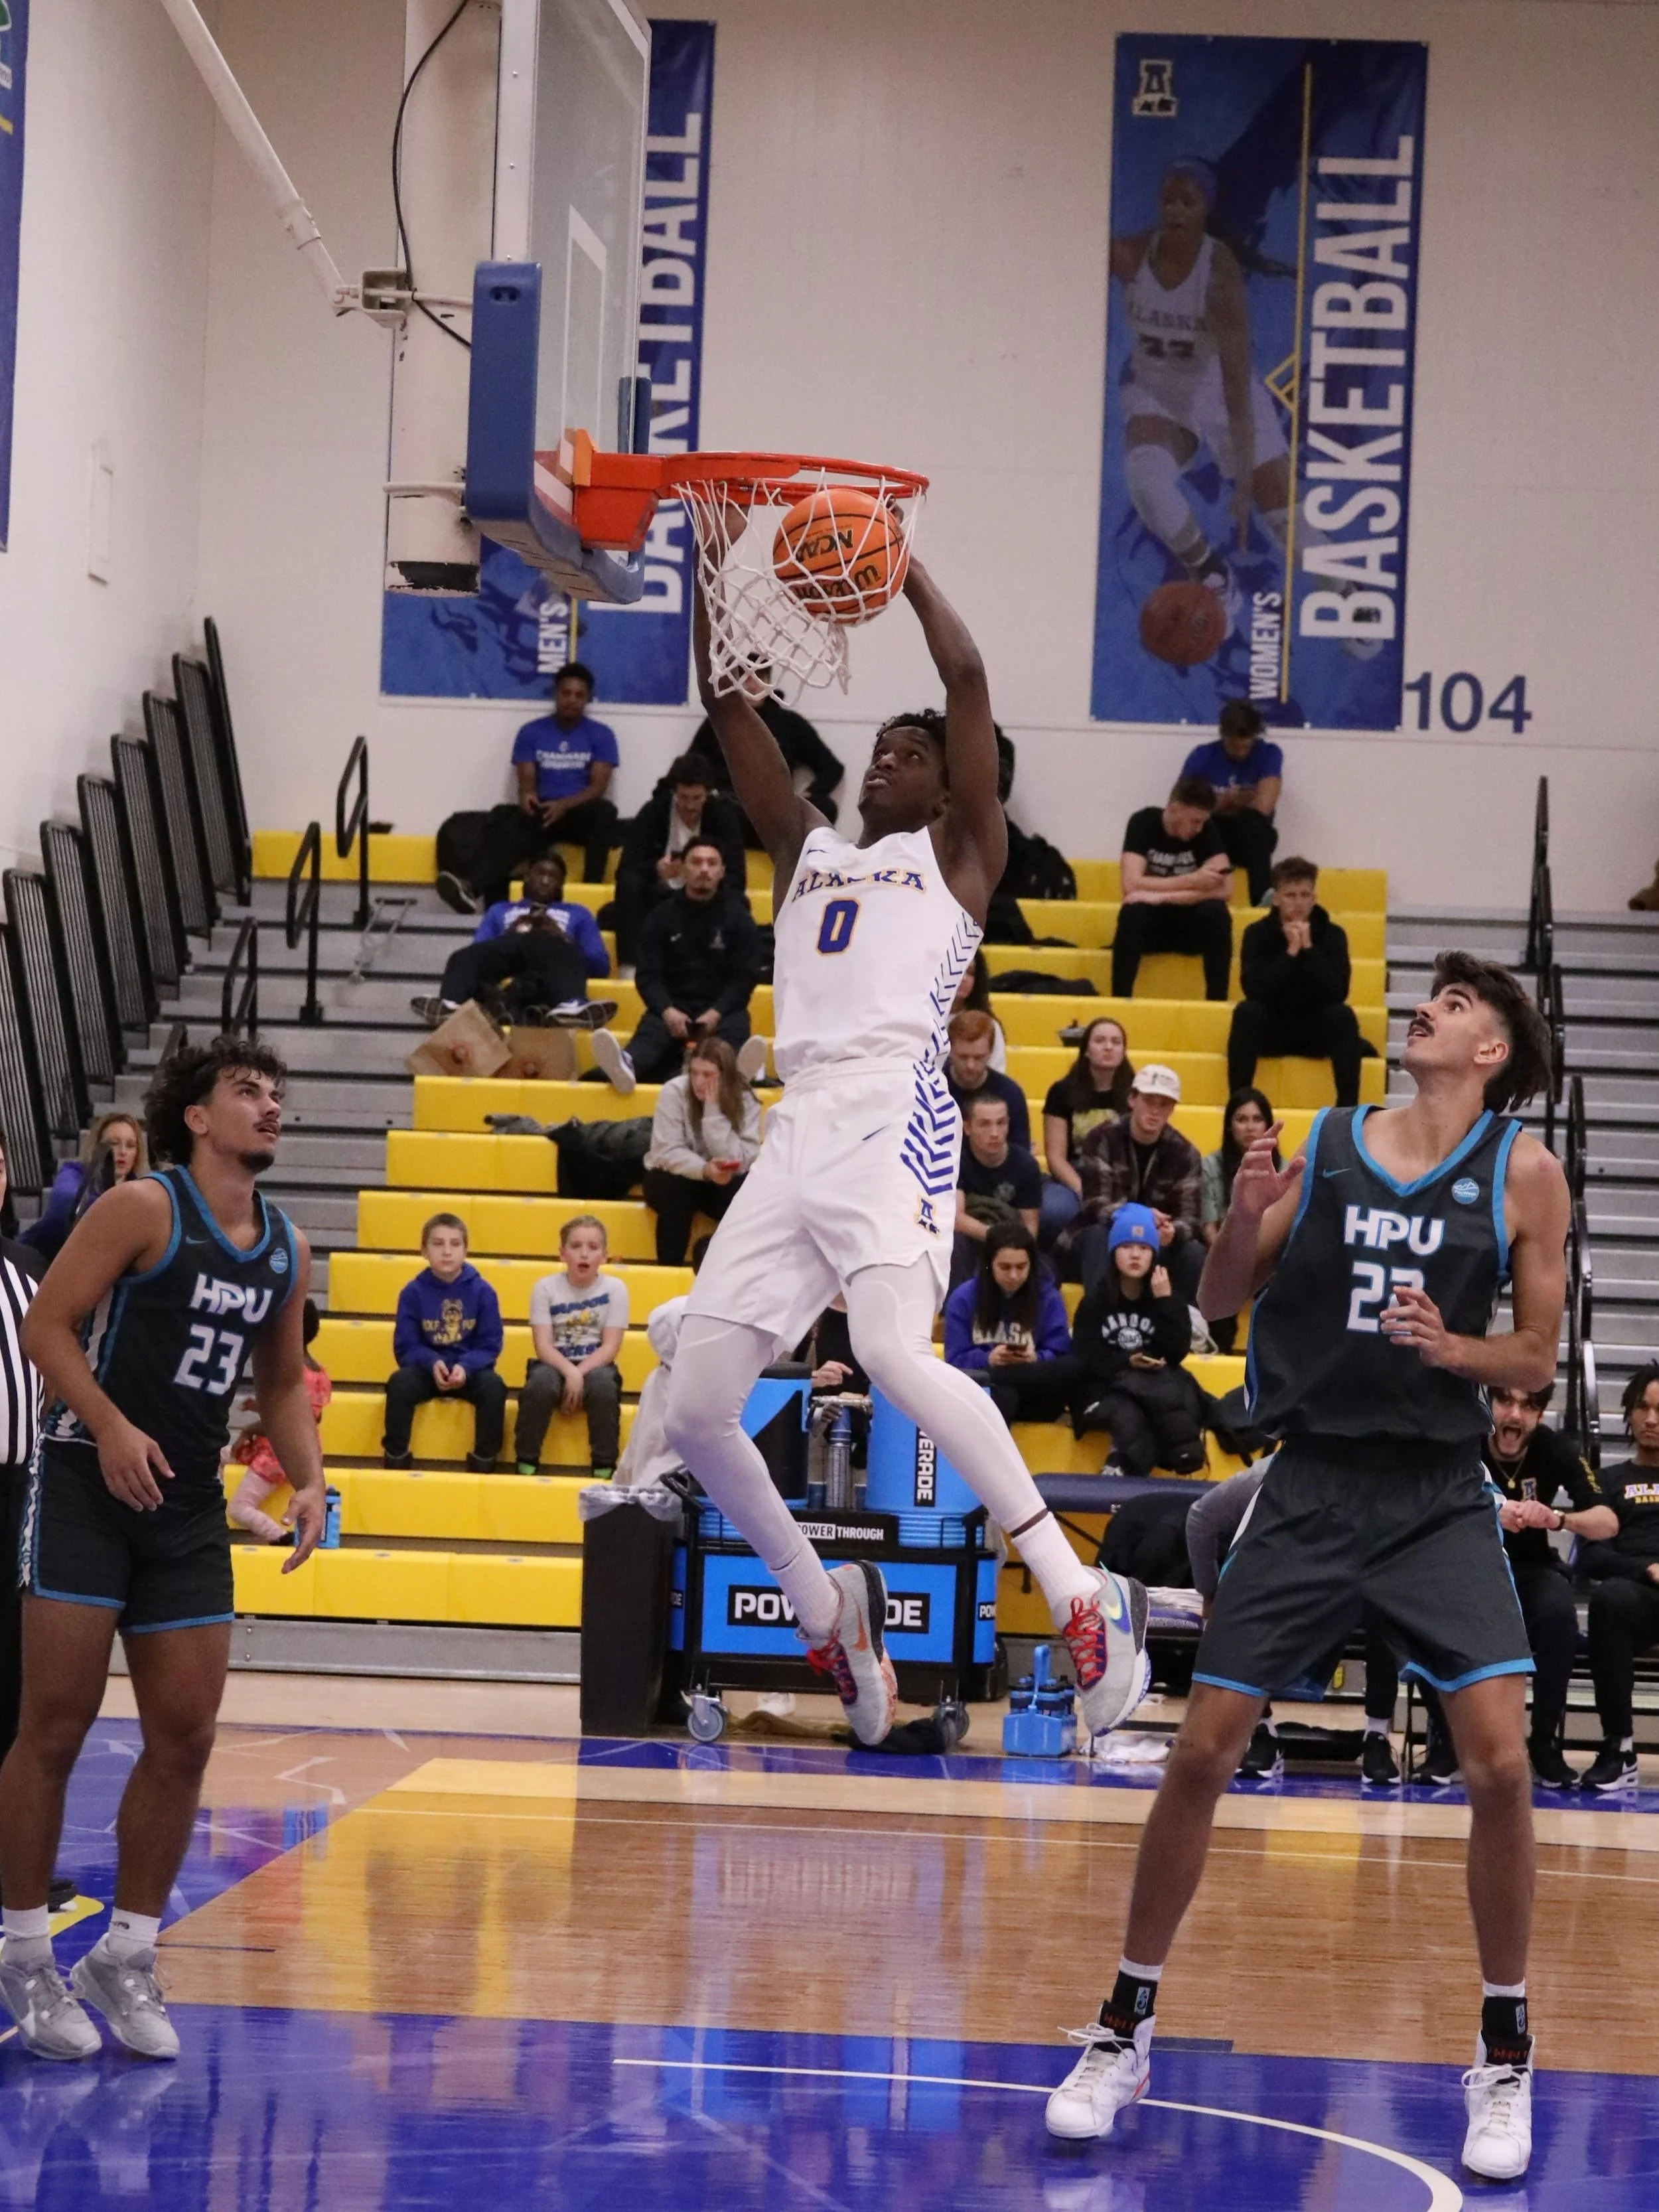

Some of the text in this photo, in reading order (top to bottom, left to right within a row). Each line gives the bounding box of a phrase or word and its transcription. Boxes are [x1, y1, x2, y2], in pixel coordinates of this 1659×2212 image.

[1299, 135, 1415, 641] BASKETBALL
[537, 601, 569, 674] MEN'S
[1249, 591, 1282, 700] WOMEN'S
[1405, 673, 1533, 734] 104
[816, 898, 861, 956] 0
[1344, 1205, 1445, 1256] HPU
[190, 1274, 272, 1323] HPU
[173, 1325, 244, 1395] 23
[917, 1430, 935, 1501] ERADE
[836, 1526, 885, 1540] THROUGH
